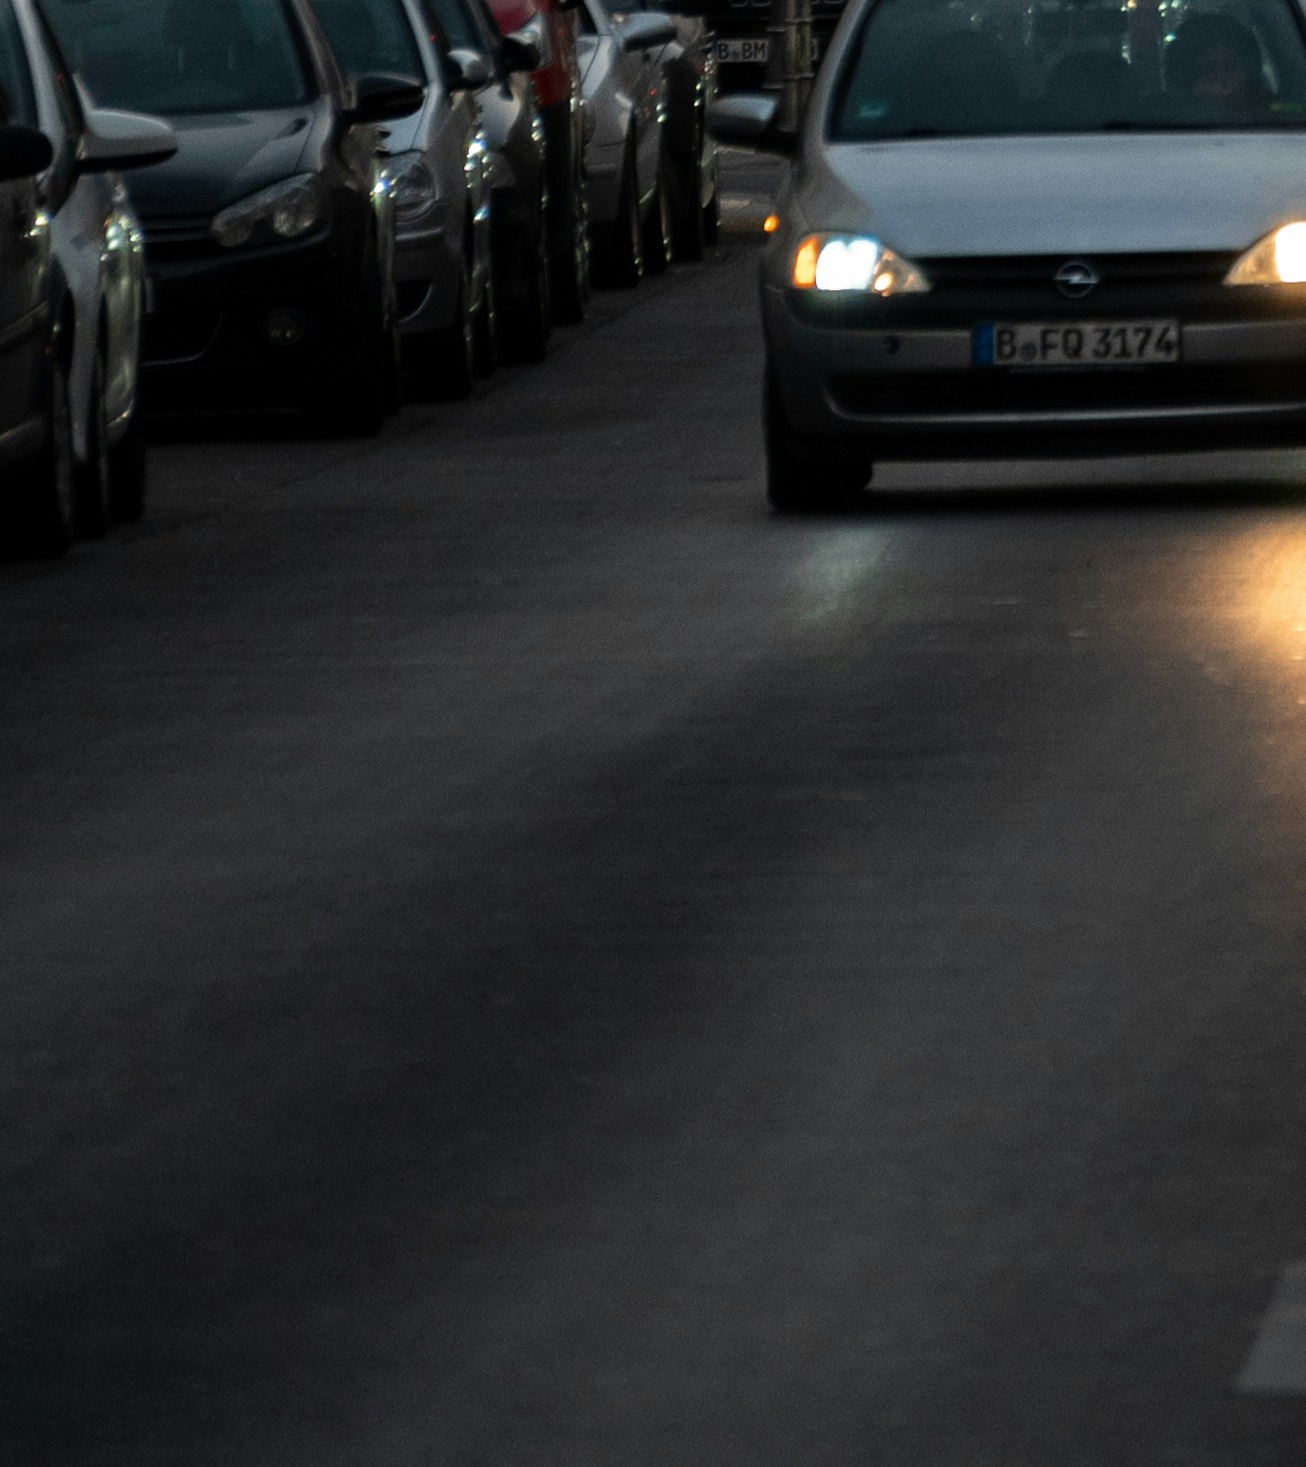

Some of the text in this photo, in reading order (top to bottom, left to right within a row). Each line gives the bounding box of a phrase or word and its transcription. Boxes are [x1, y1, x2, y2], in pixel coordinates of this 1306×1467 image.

[718, 43, 729, 60] B
[996, 326, 1175, 360] B FQ 3174
